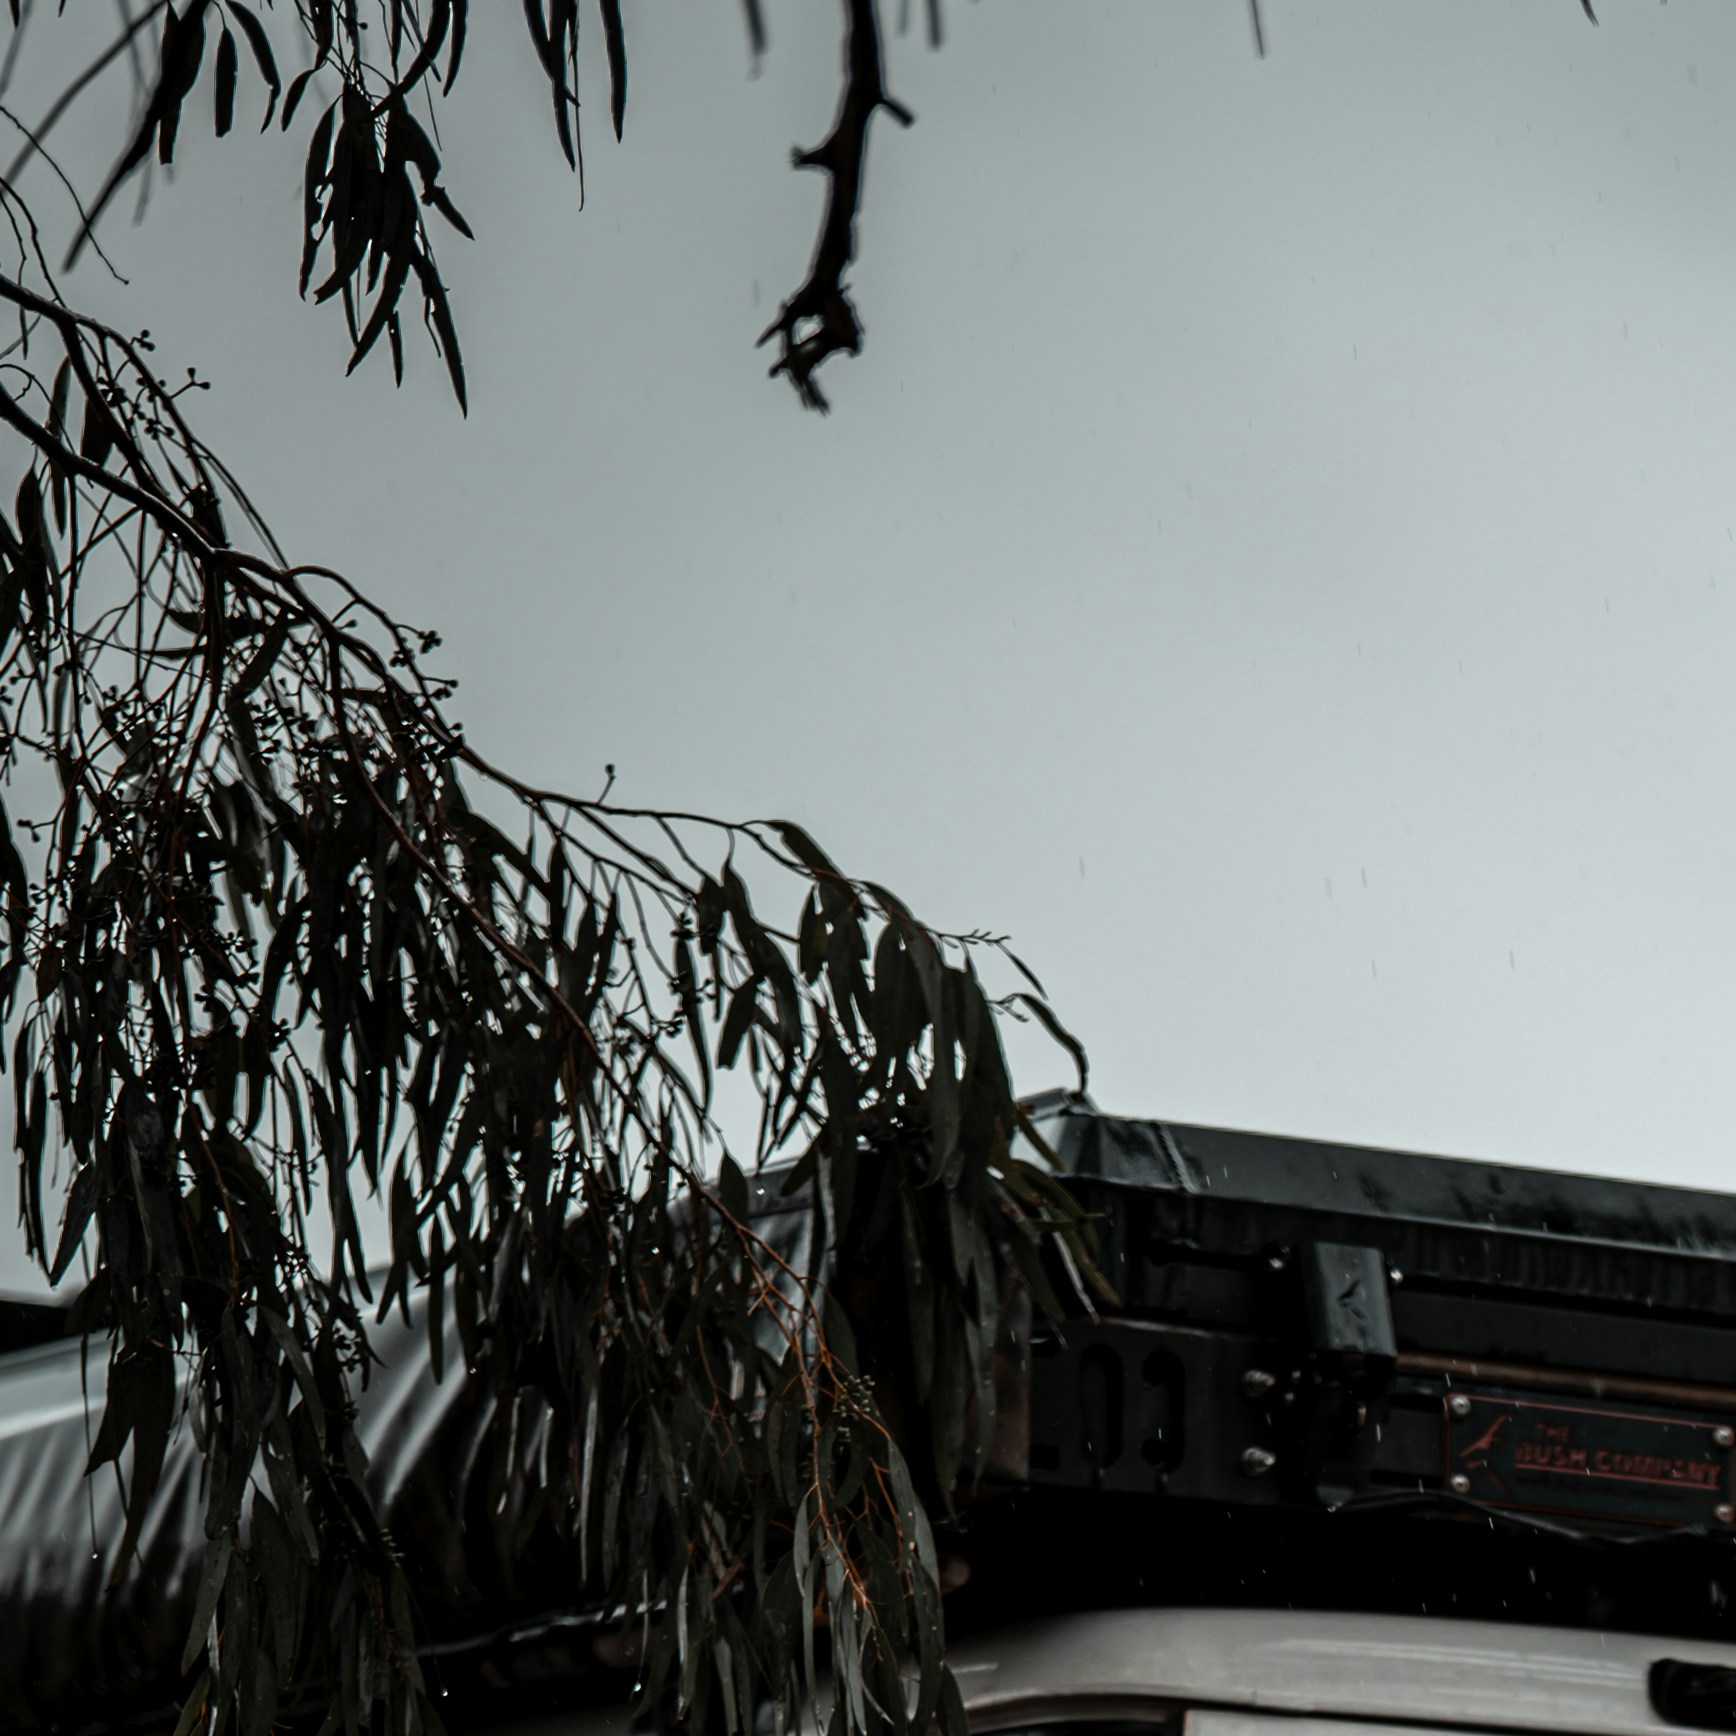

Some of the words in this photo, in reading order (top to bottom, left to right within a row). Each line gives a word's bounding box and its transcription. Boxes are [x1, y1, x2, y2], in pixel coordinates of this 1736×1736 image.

[1536, 1422, 1570, 1442] THE
[1514, 1440, 1588, 1467] BUSH
[1594, 1449, 1723, 1485] COMPANY
